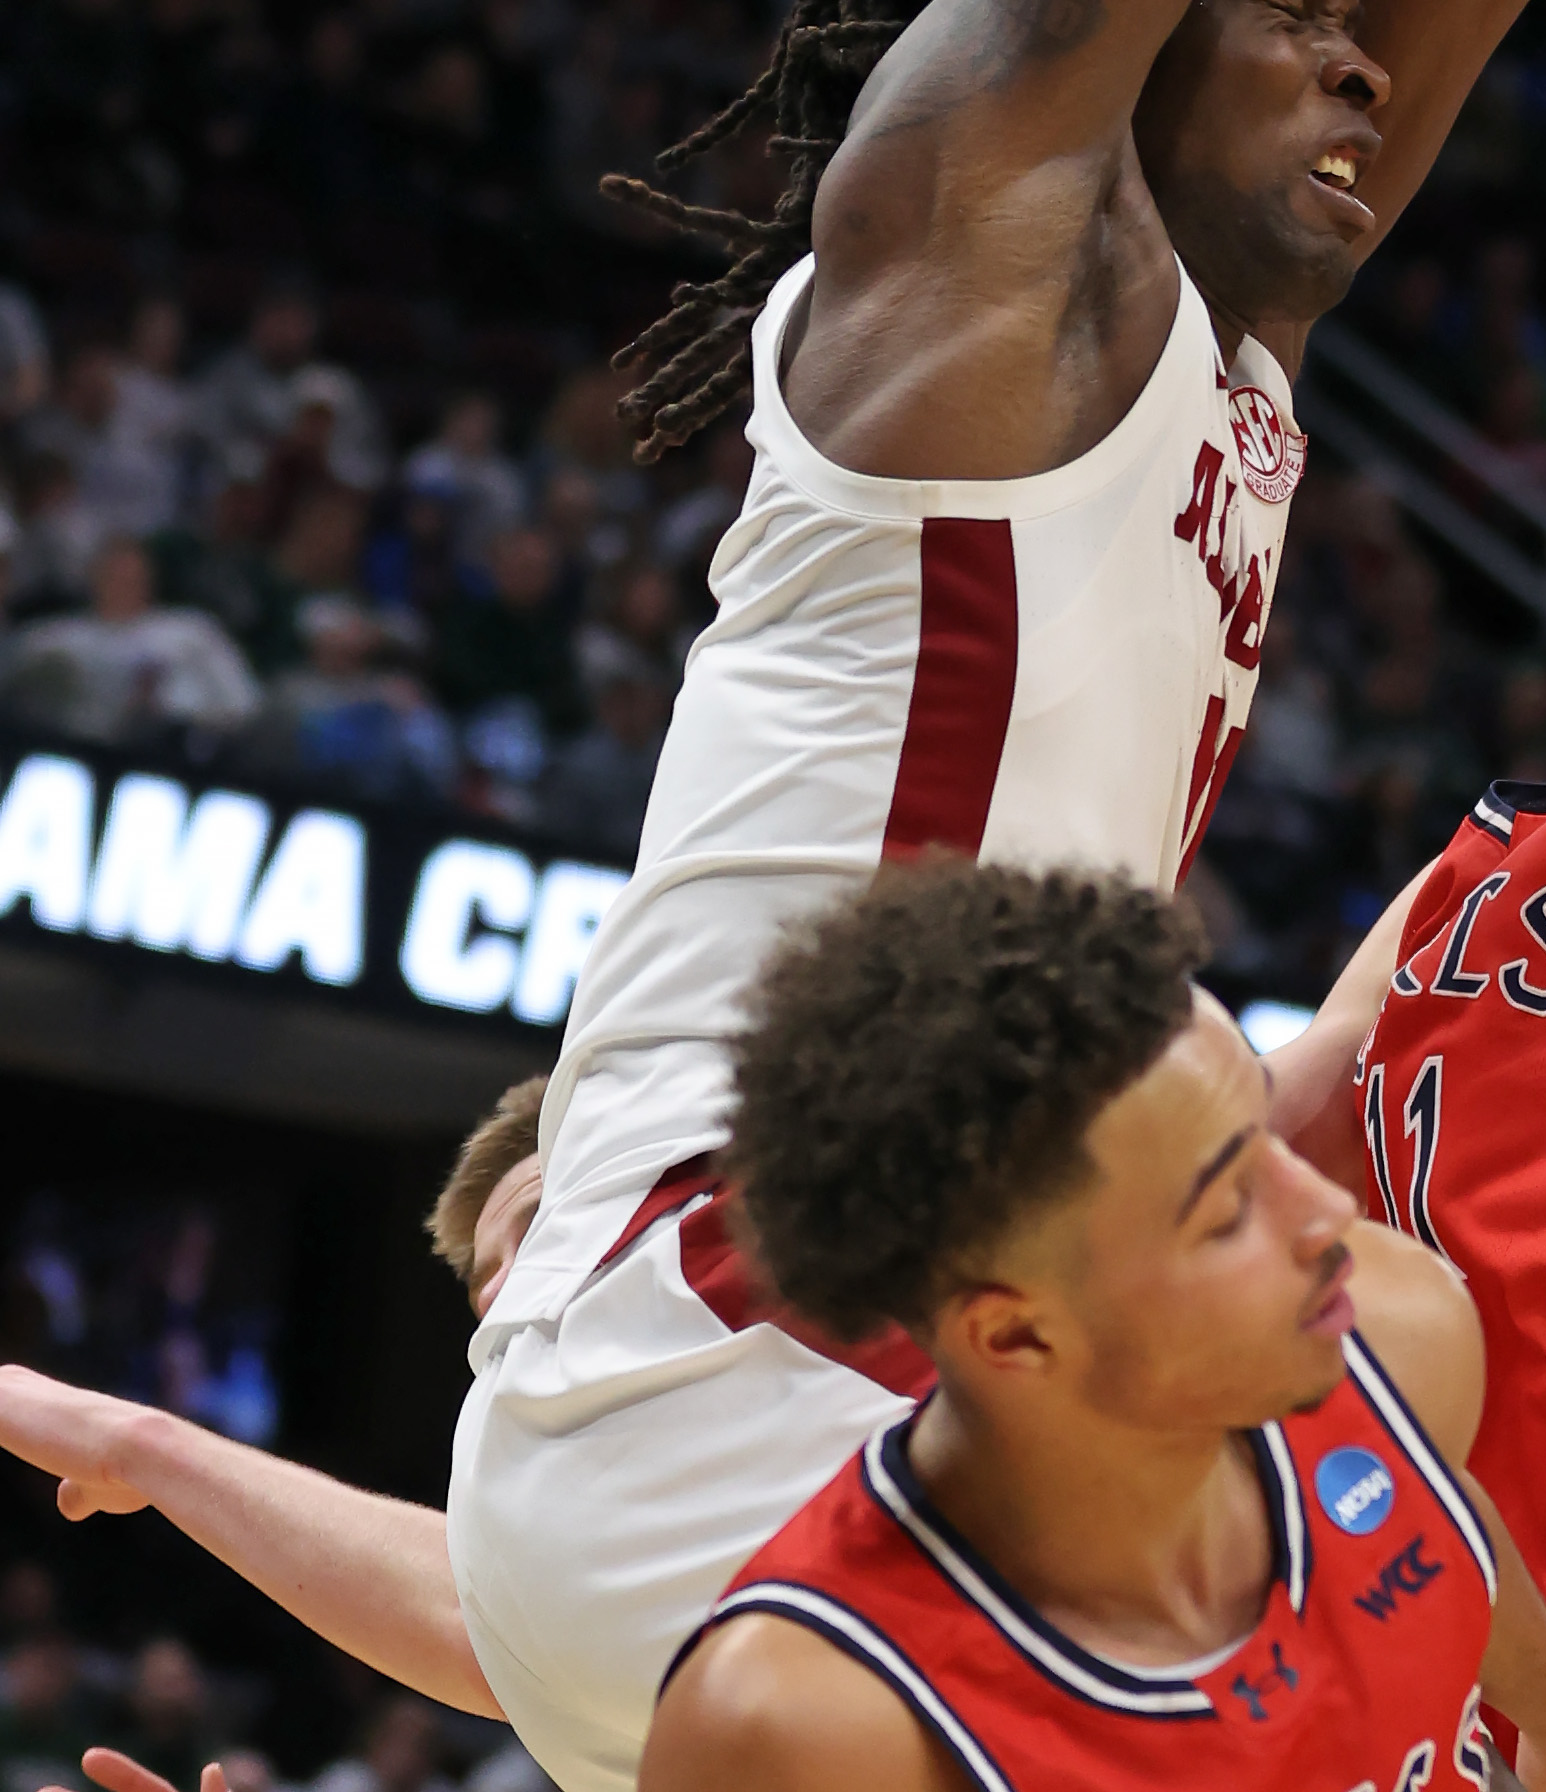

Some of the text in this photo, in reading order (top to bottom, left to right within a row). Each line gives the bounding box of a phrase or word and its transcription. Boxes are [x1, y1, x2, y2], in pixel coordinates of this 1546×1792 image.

[1229, 391, 1281, 473] SEC
[1246, 457, 1302, 501] GRADUATE
[1353, 1534, 1444, 1624] WCC
